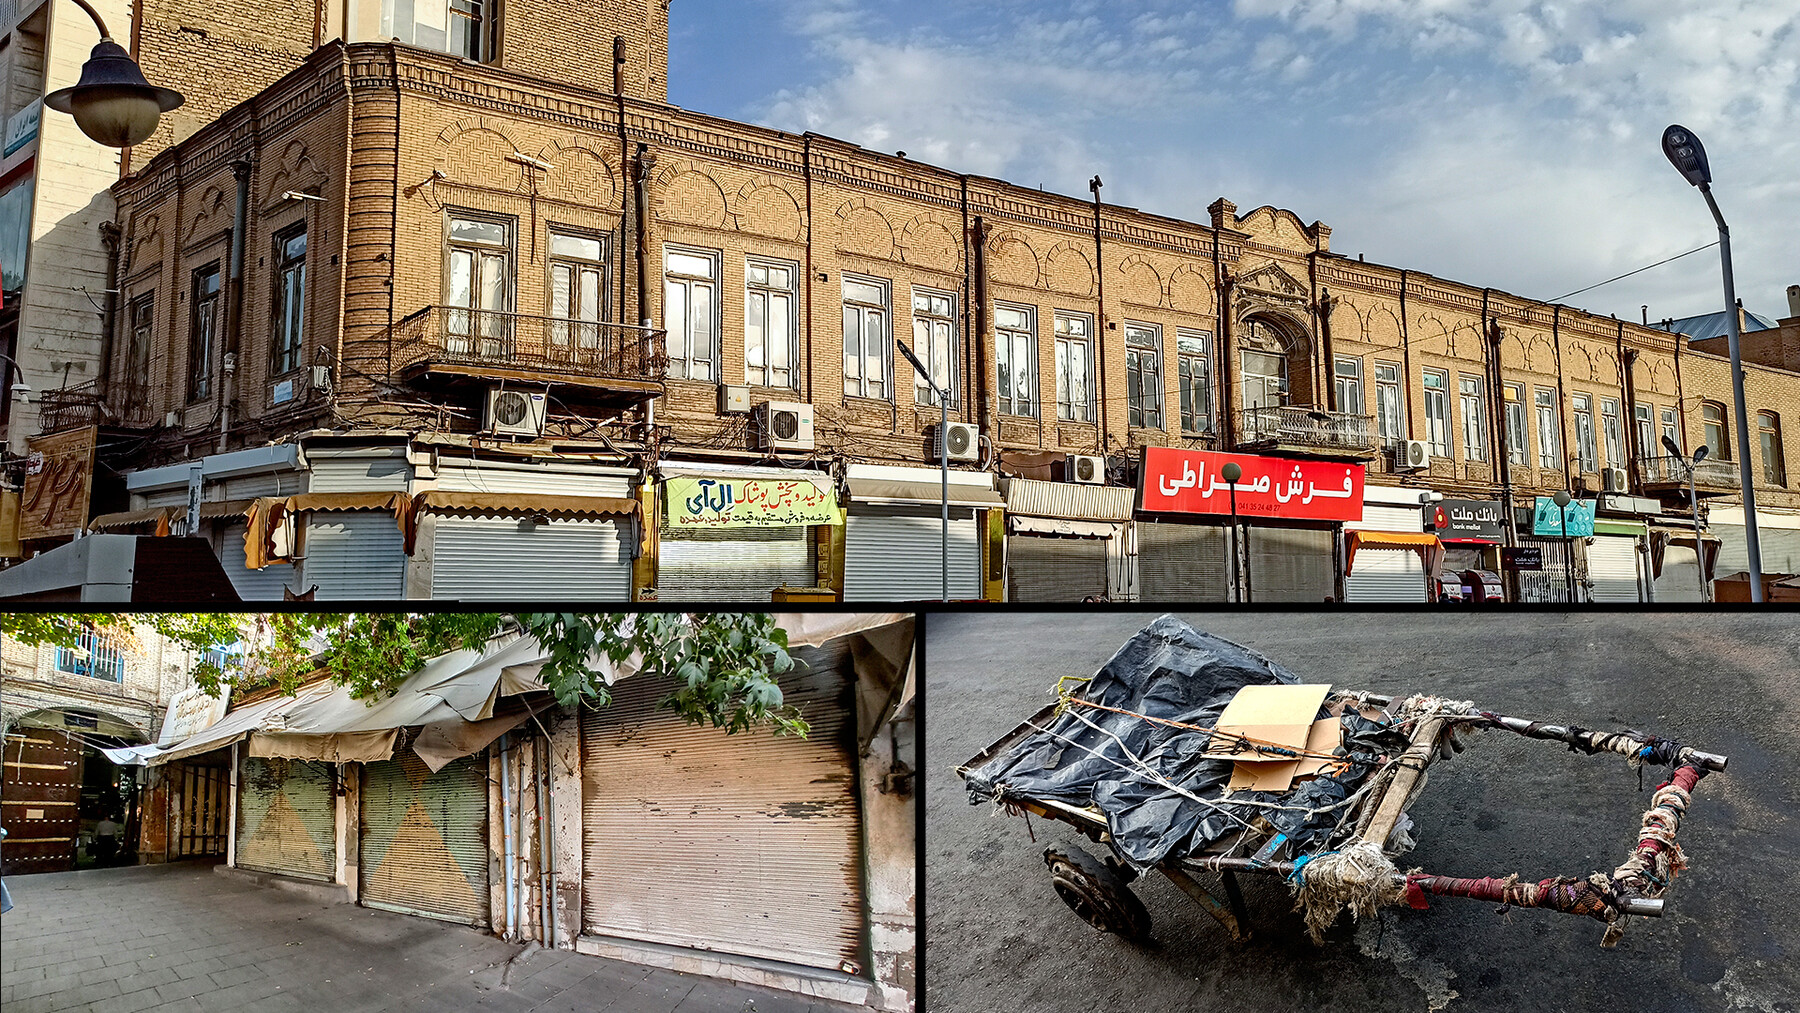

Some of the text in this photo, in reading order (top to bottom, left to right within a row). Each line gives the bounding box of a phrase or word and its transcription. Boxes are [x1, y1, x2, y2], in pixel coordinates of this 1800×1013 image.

[1159, 459, 1353, 504] فرش صراطی
[734, 481, 768, 512] پوشاک
[767, 481, 799, 509] پخش
[795, 492, 800, 501] و
[801, 485, 825, 507] ولید
[708, 511, 731, 526] تولید
[732, 511, 754, 524] قیمت
[761, 512, 784, 525] مستقیم
[784, 510, 805, 524] فروش
[810, 513, 832, 523] عرضه
[1451, 506, 1474, 521] ملت
